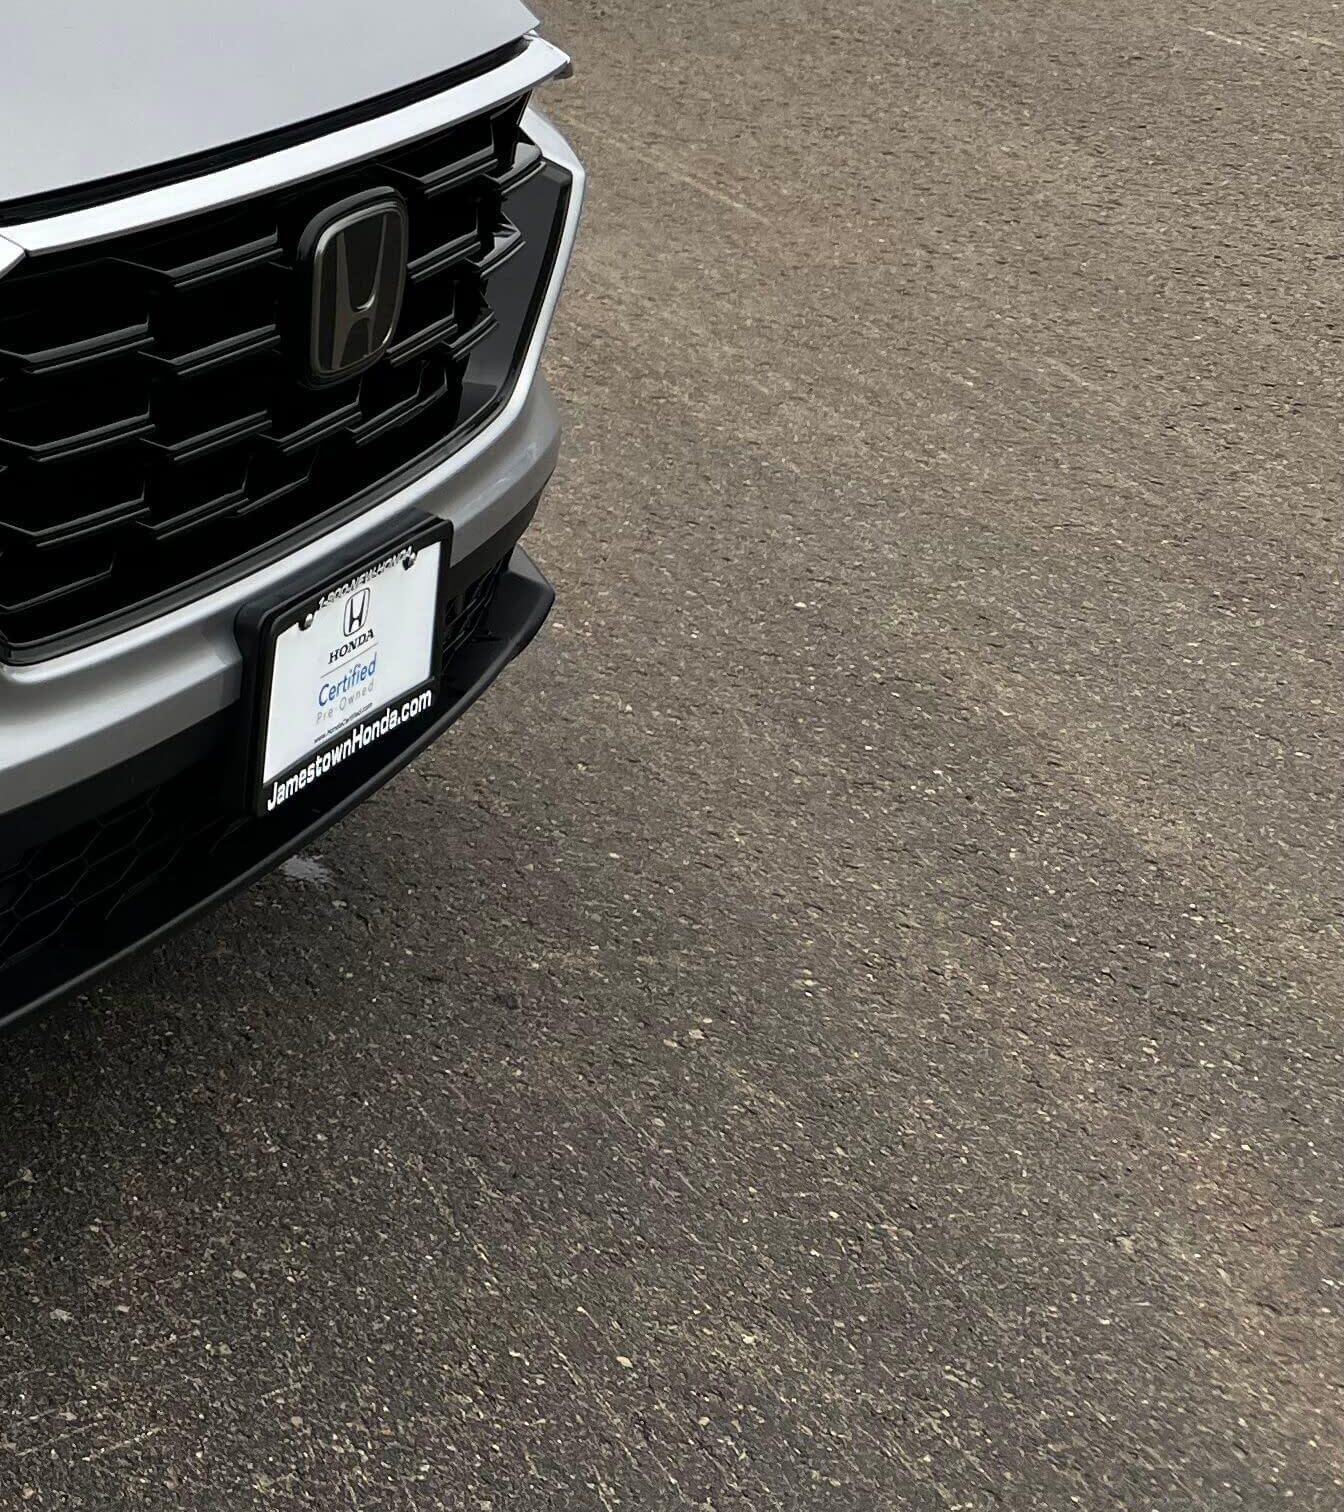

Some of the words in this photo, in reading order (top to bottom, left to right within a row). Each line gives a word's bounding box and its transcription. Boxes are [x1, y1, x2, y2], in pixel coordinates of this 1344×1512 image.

[328, 628, 374, 664] HONDA
[318, 651, 378, 707] Certified
[267, 689, 433, 812] JamestownHonda.com
